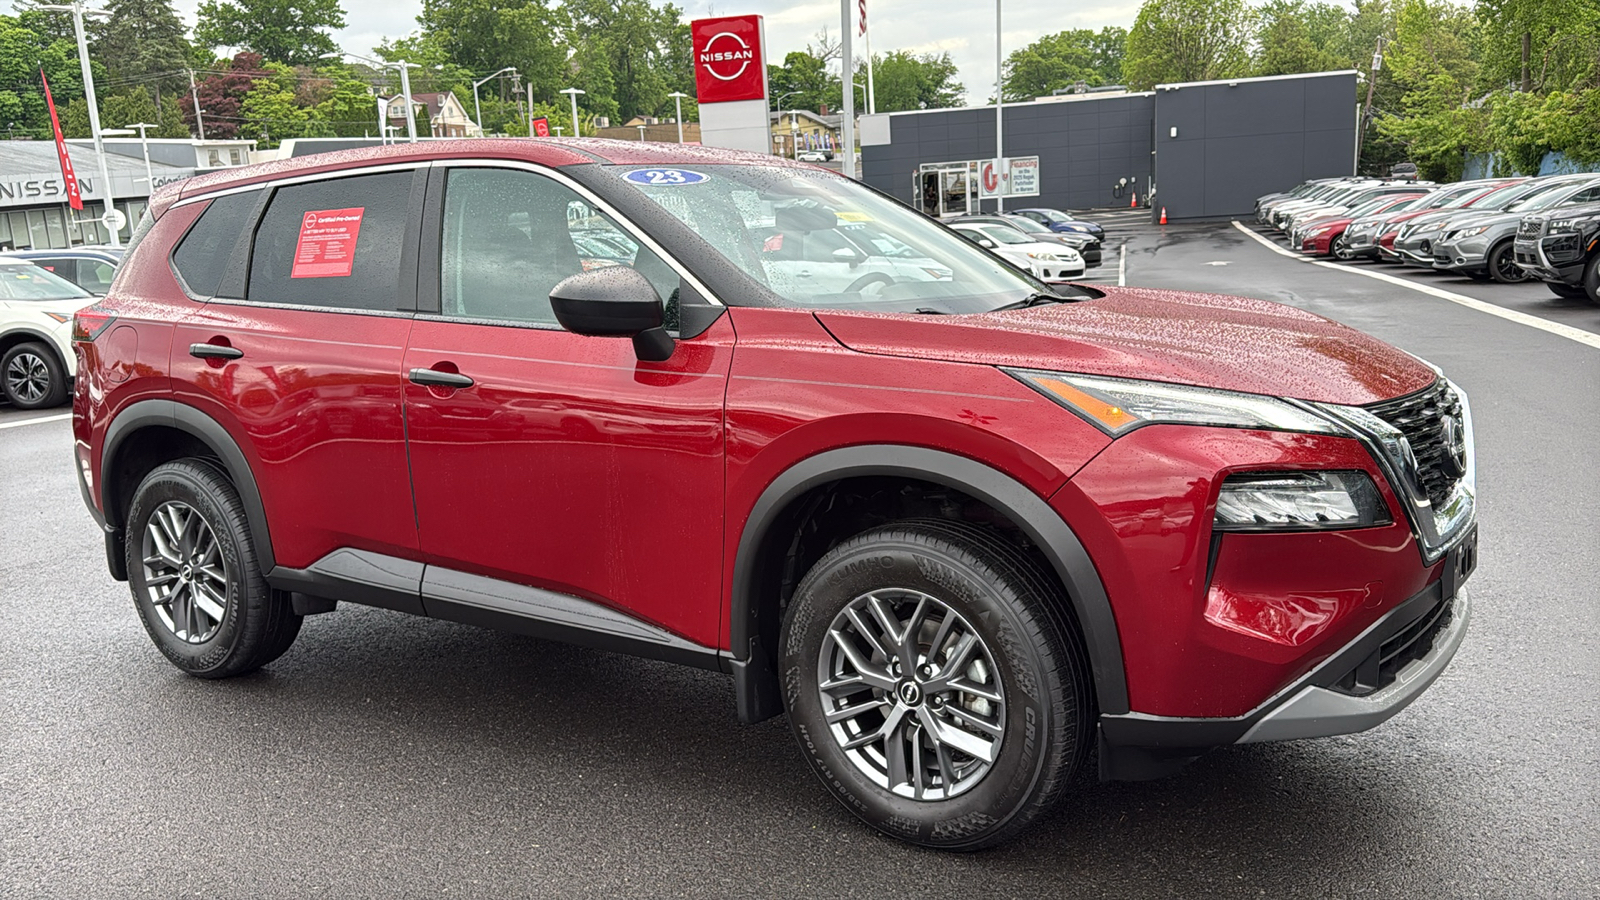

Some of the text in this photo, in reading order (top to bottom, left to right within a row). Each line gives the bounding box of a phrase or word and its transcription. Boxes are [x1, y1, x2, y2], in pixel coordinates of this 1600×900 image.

[700, 50, 753, 62] NISSAN
[646, 170, 687, 184] 23
[0, 178, 93, 200] NISSN
[228, 581, 239, 637] KUMHO
[798, 724, 818, 755] 104H
[815, 758, 834, 780] R17
